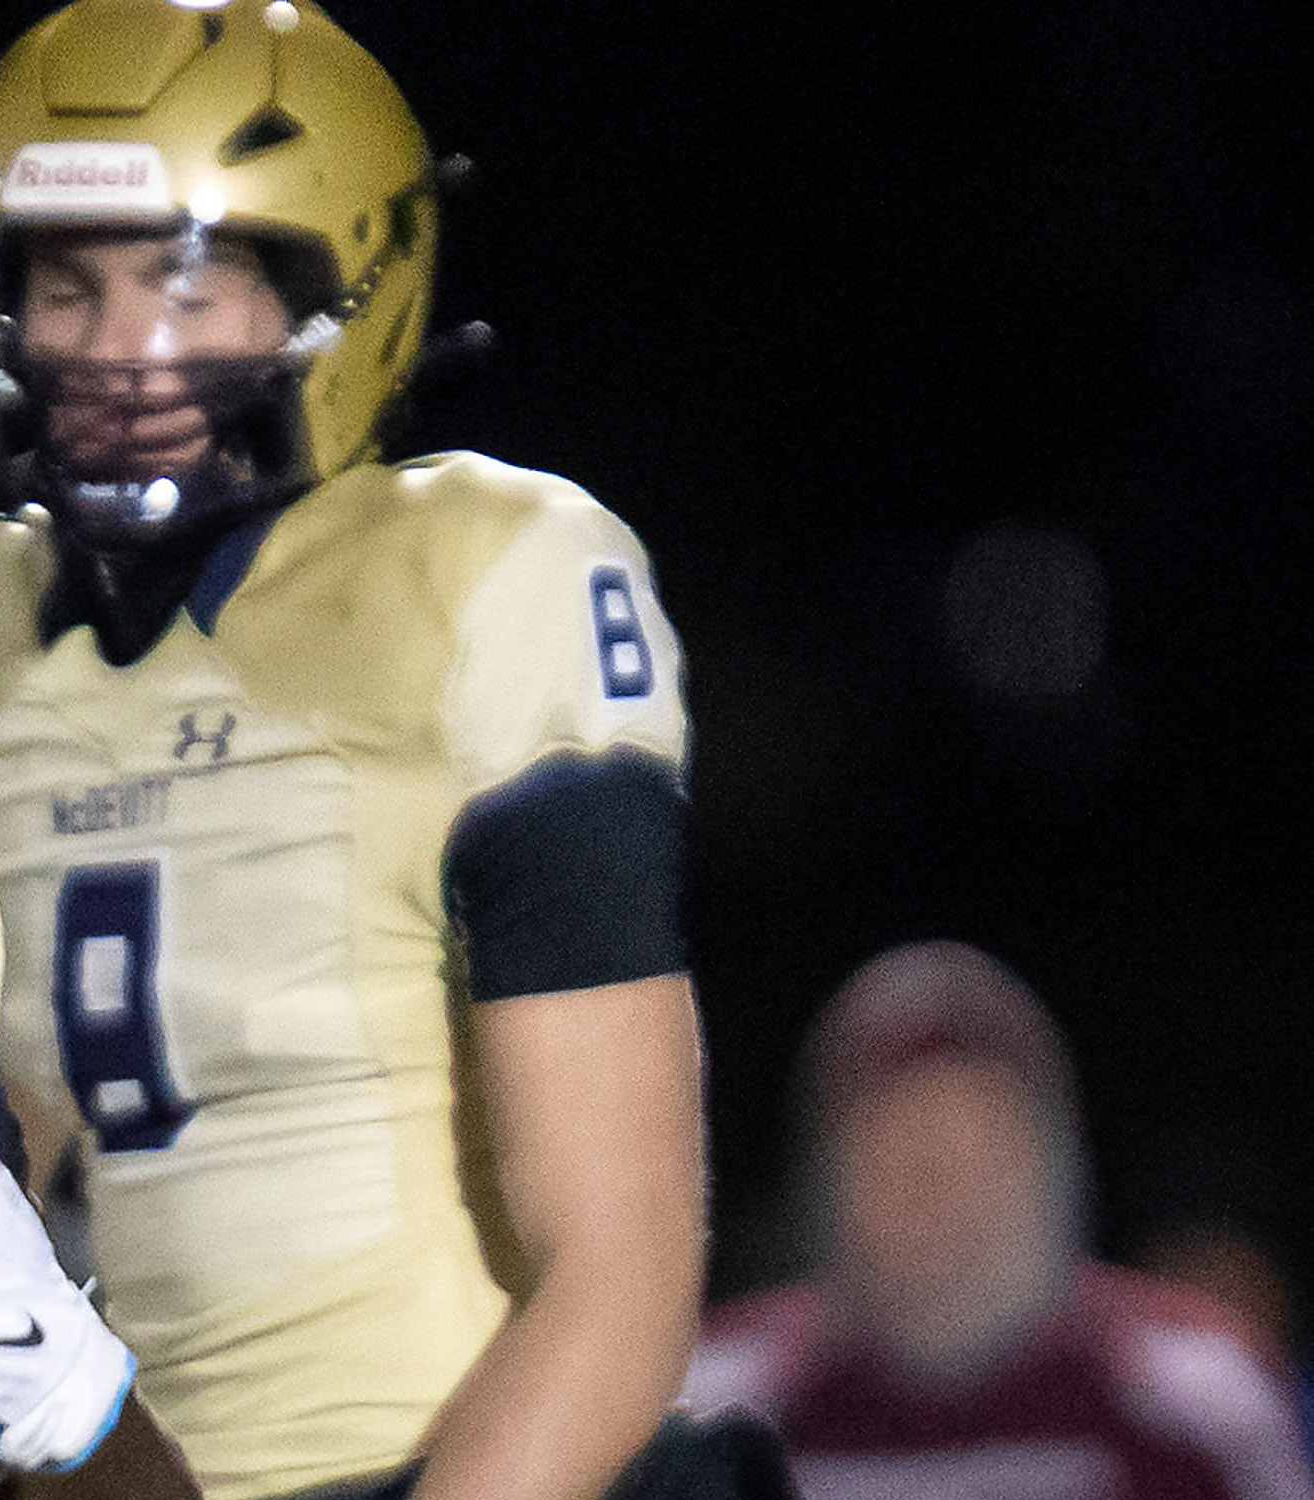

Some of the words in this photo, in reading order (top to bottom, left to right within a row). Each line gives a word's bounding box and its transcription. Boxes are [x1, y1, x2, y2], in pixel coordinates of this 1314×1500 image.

[18, 157, 149, 186] Riddell
[589, 565, 654, 699] 8
[50, 858, 203, 1153] 8
